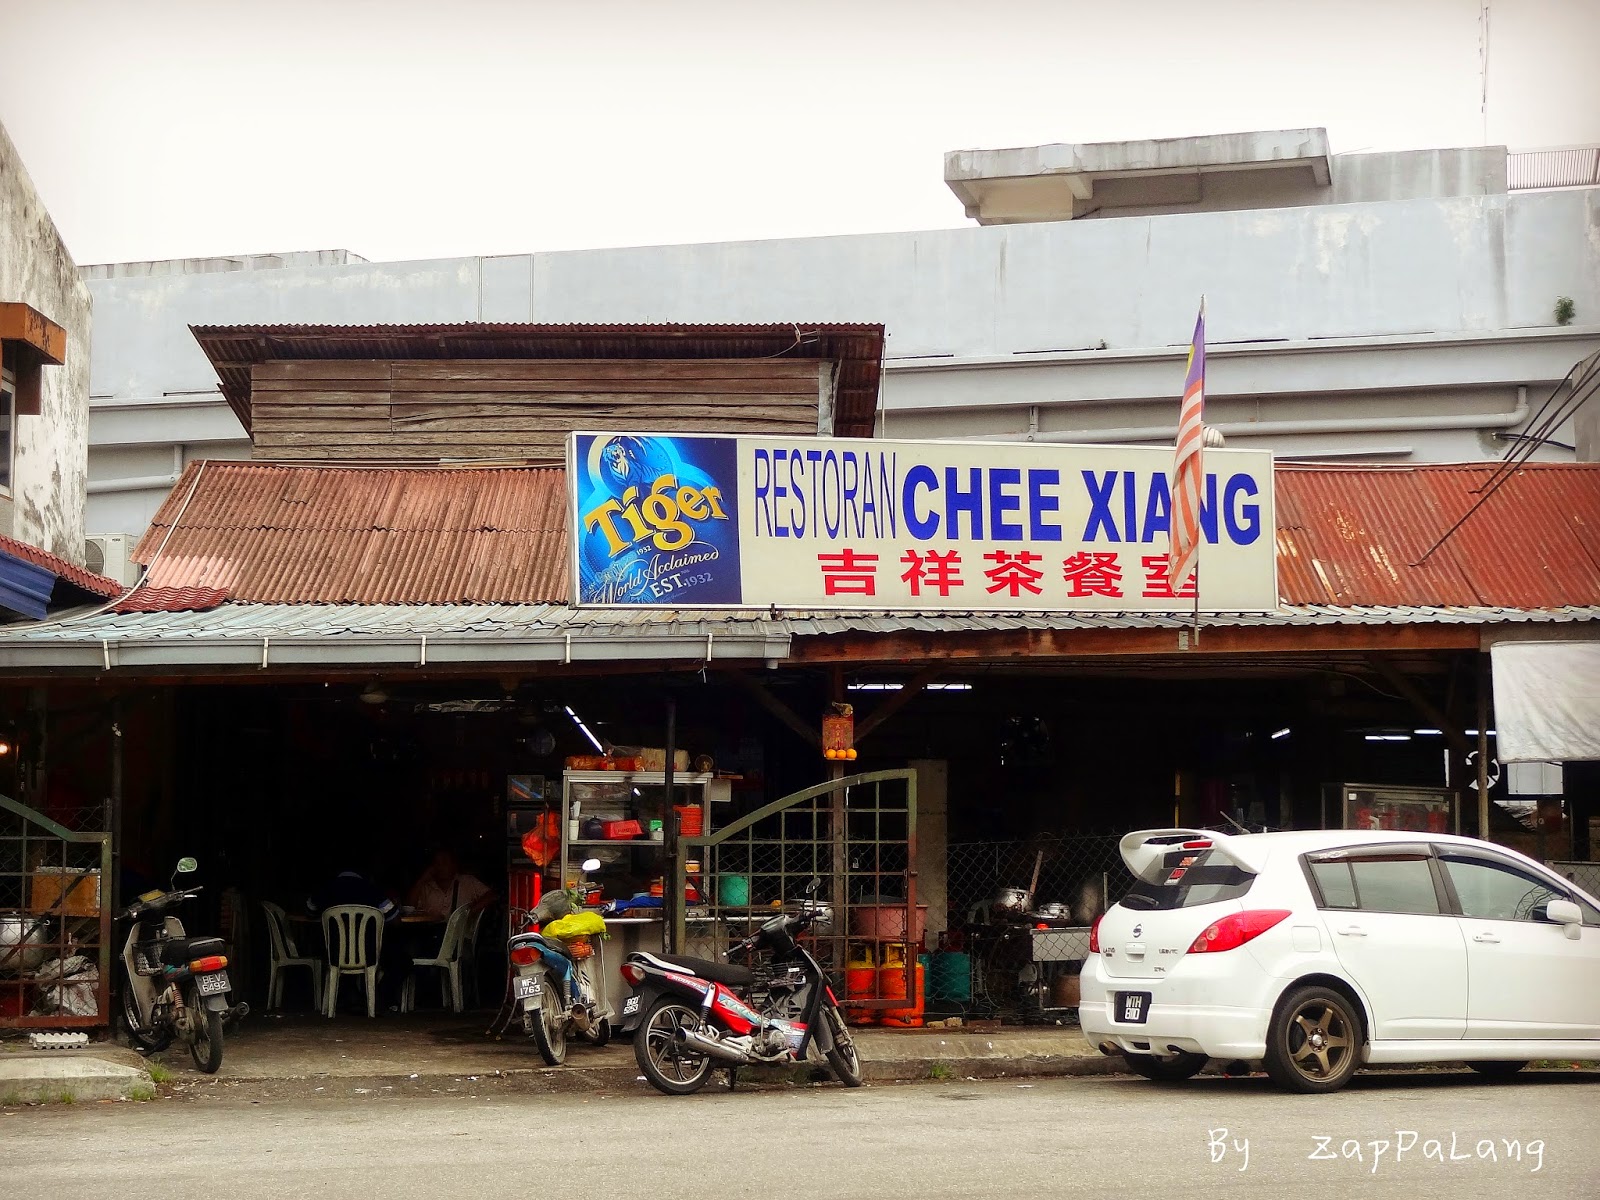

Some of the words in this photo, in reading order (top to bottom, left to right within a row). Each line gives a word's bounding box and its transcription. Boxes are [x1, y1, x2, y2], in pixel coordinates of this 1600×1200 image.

[754, 448, 897, 539] RESTORAN
[902, 464, 1062, 542] CHEE
[583, 474, 729, 558] Tiger
[636, 545, 652, 556] 1932
[589, 558, 648, 604] World
[643, 545, 719, 580] Acclaimed
[818, 548, 1200, 598] 吉祥茶餐室
[649, 573, 687, 598] EST.
[684, 572, 713, 587] 1932
[202, 973, 221, 984] BEV
[521, 976, 537, 987] WFJ
[202, 981, 227, 992] 6492
[520, 985, 540, 996] 1763
[1126, 995, 1142, 1008] WTH
